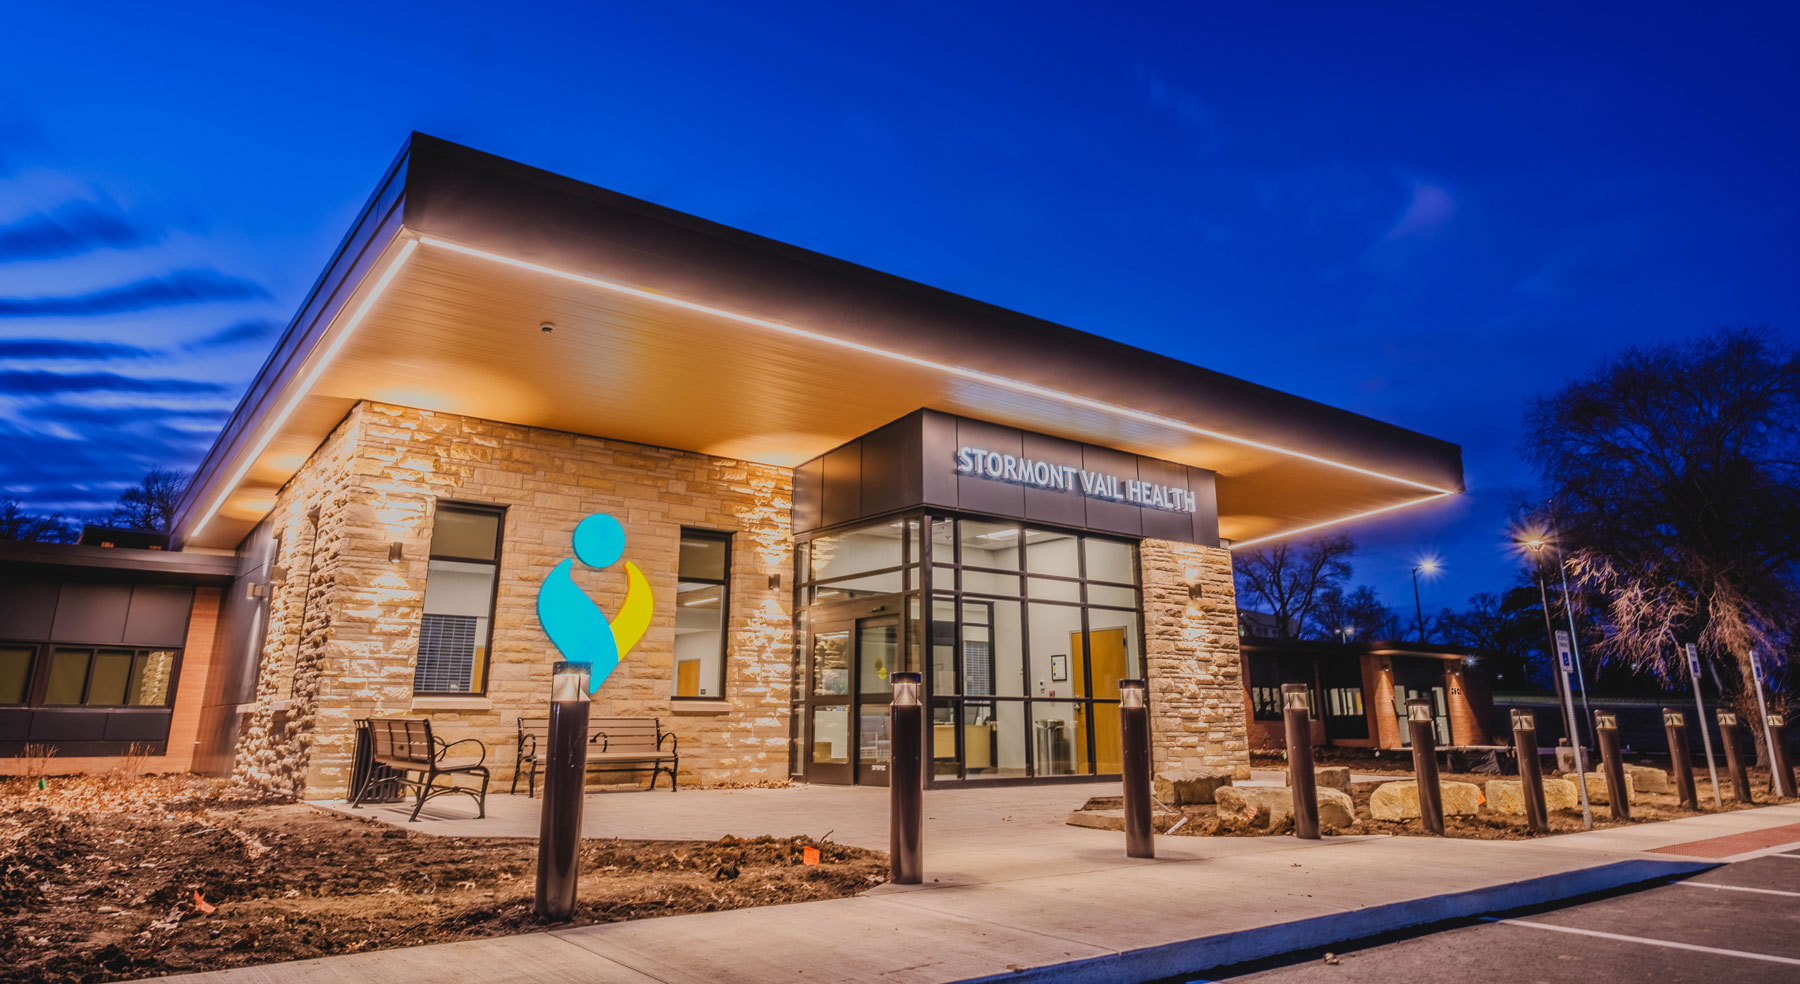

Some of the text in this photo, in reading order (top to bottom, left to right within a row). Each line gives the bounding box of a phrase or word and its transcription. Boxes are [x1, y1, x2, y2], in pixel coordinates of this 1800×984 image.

[957, 446, 1196, 513] STORMONT VAIL HEALTH
